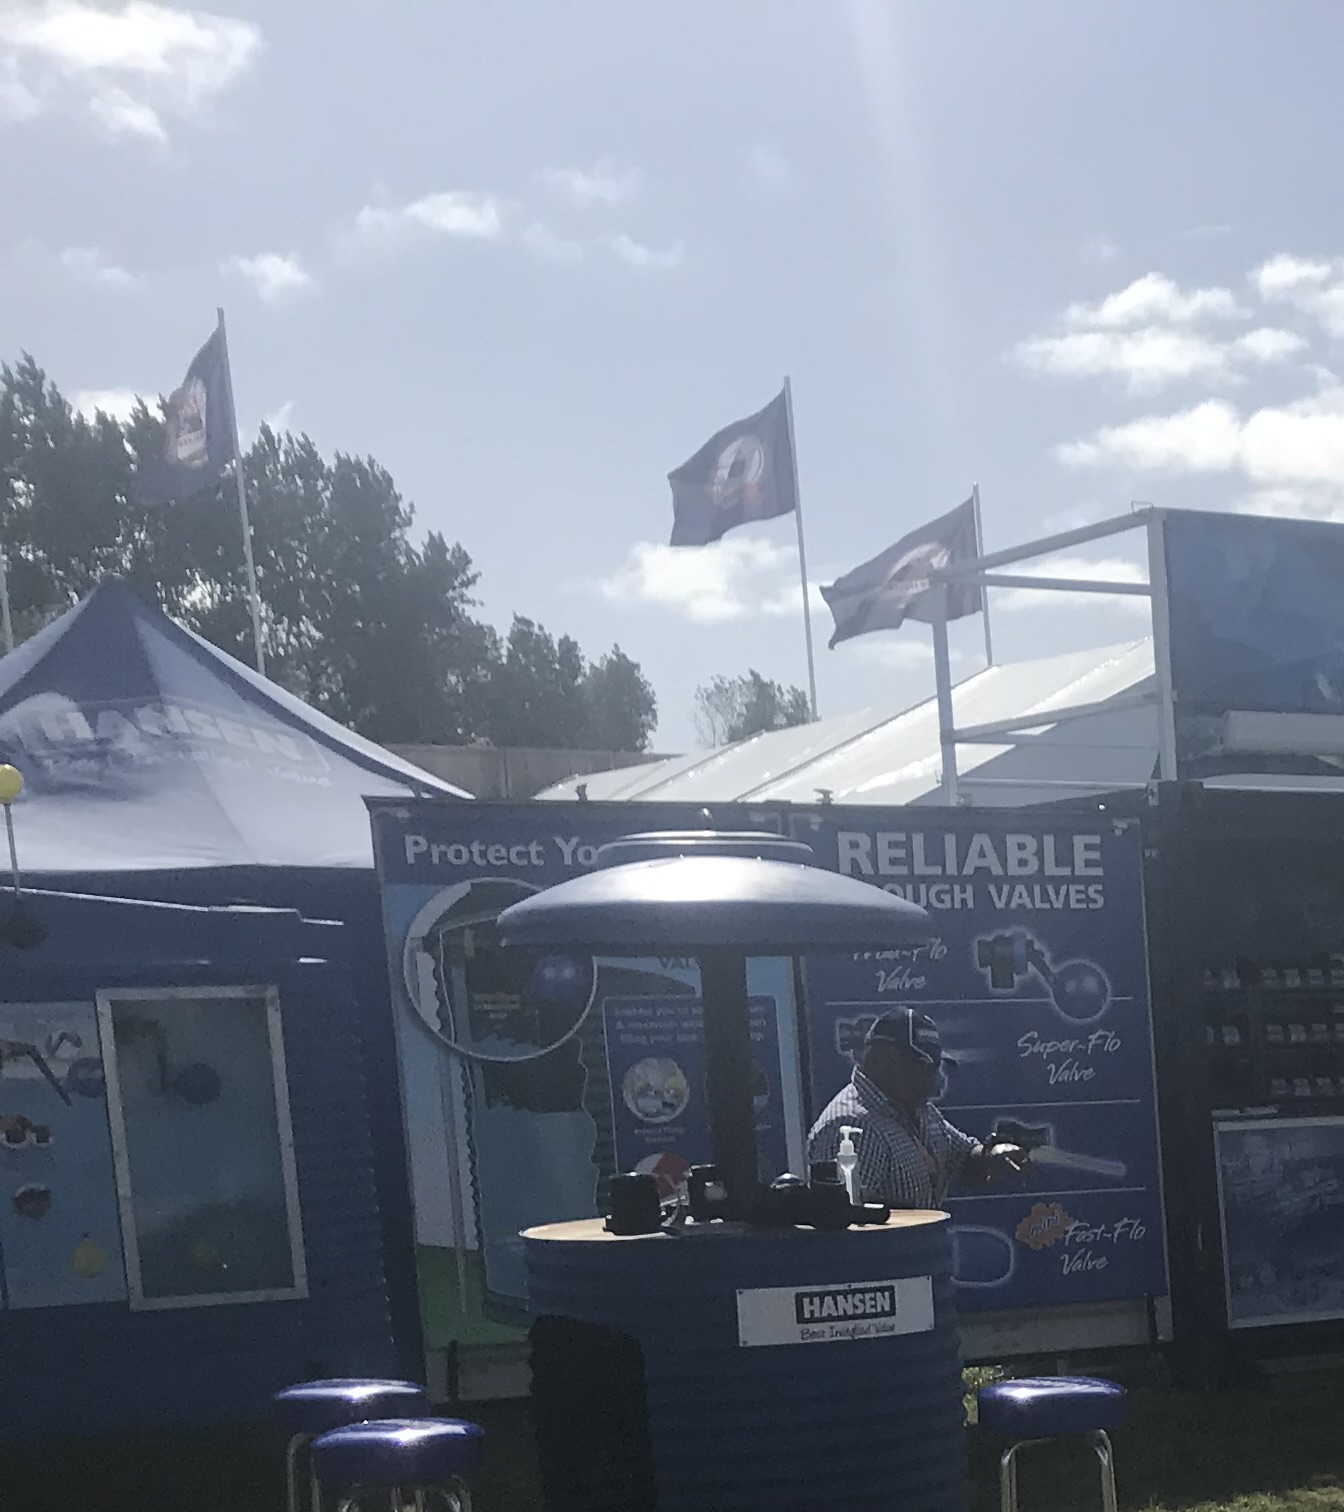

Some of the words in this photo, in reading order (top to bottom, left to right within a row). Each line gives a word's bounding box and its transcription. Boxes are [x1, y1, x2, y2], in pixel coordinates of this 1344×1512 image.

[38, 702, 305, 761] HANSEN
[404, 834, 545, 866] Protect
[553, 836, 602, 866] Yo
[837, 830, 1104, 877] RELIABLE
[883, 883, 975, 910] OUGH
[988, 883, 1105, 911] VALVES
[875, 965, 927, 992] Valve
[1046, 1059, 1097, 1084] Valve
[1060, 1248, 1110, 1275] Valve
[802, 1291, 891, 1318] HANSEN
